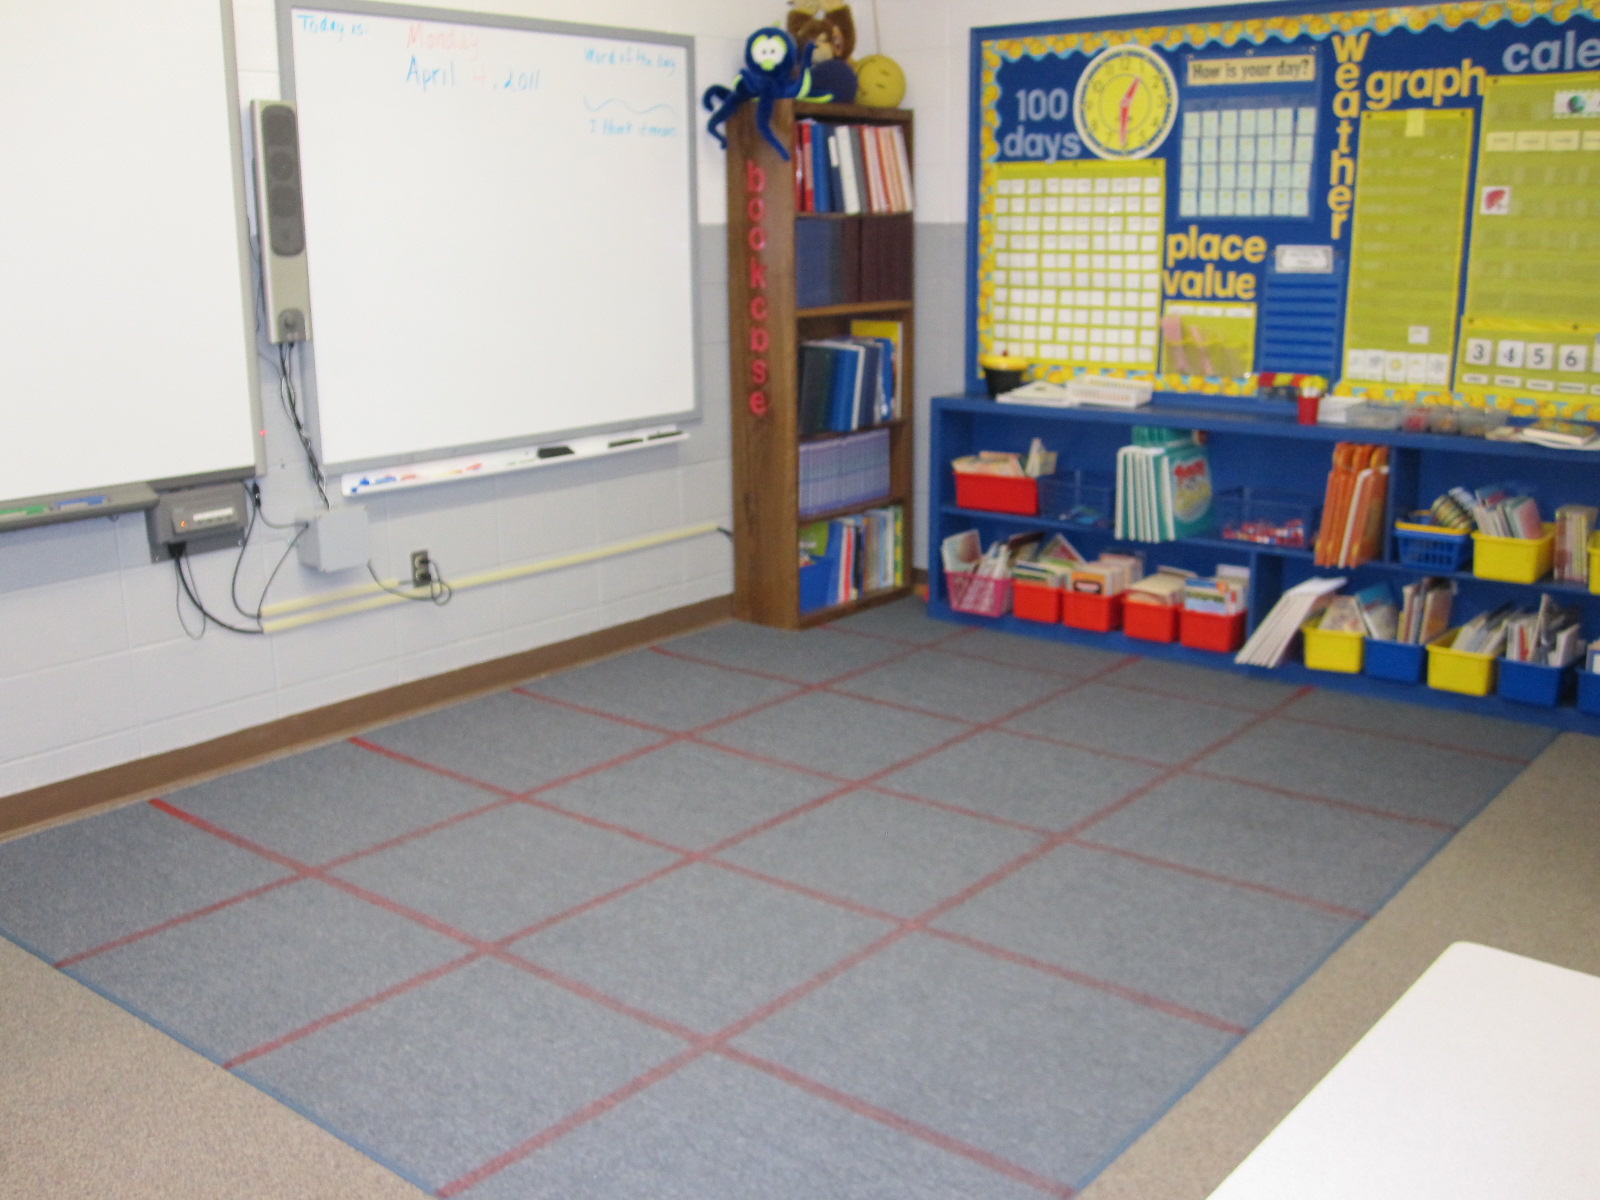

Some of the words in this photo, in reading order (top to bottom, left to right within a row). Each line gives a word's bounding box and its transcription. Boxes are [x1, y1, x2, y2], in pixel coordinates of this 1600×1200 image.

[405, 56, 456, 91] April
[1193, 63, 1220, 78] How
[1225, 62, 1237, 78] is
[1241, 64, 1271, 81] your
[1277, 58, 1310, 79] day?
[1366, 58, 1487, 110] graph
[1015, 88, 1069, 121] 100
[1004, 126, 1082, 164] days
[1166, 225, 1267, 267] place
[1163, 264, 1257, 299] value
[1472, 344, 1485, 361] 3
[1533, 348, 1545, 365] 5
[1565, 350, 1578, 368] 6
